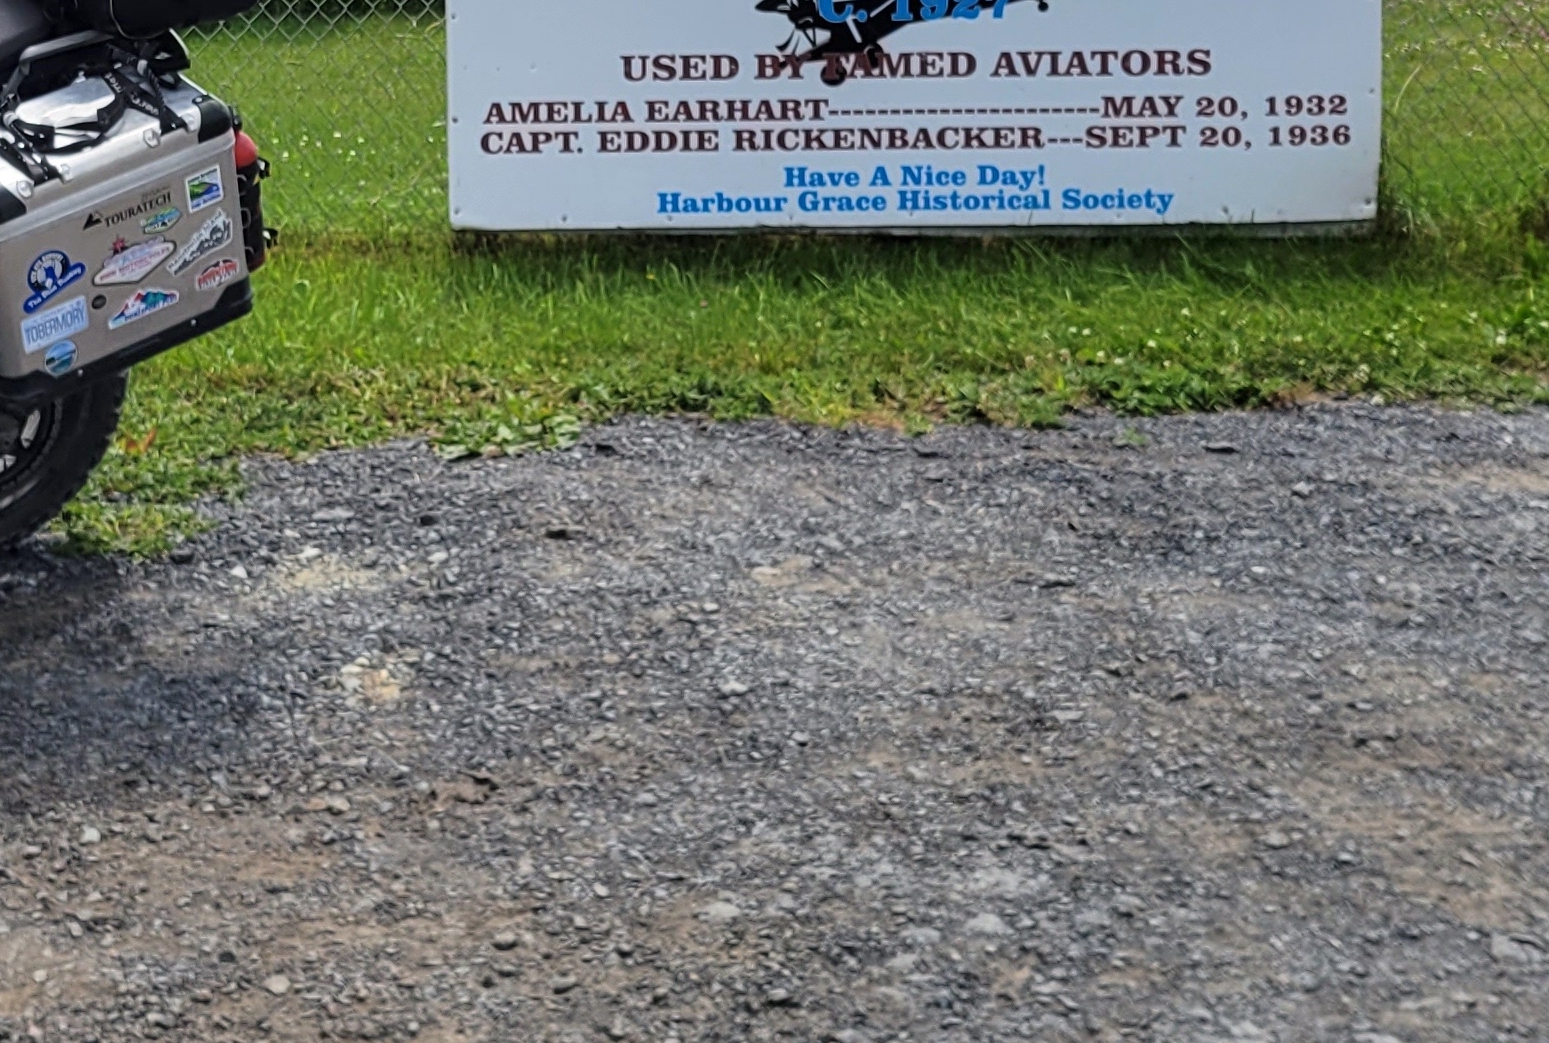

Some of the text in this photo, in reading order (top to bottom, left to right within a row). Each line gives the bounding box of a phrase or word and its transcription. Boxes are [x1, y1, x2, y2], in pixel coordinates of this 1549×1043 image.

[619, 48, 1212, 82] USED BY FAMED AVIATORS
[482, 100, 635, 125] AMELIA
[1195, 95, 1249, 121] 20,
[1264, 94, 1348, 117] 1932
[480, 130, 583, 155] CAPT.
[596, 129, 720, 153] EDDIE
[1199, 125, 1252, 151] 20,
[1268, 124, 1352, 147] 1936
[783, 164, 1045, 192] Have A Nice Day!
[657, 188, 1175, 216] Harbour Grace Historical Society
[25, 307, 85, 345] TOBERMORY
